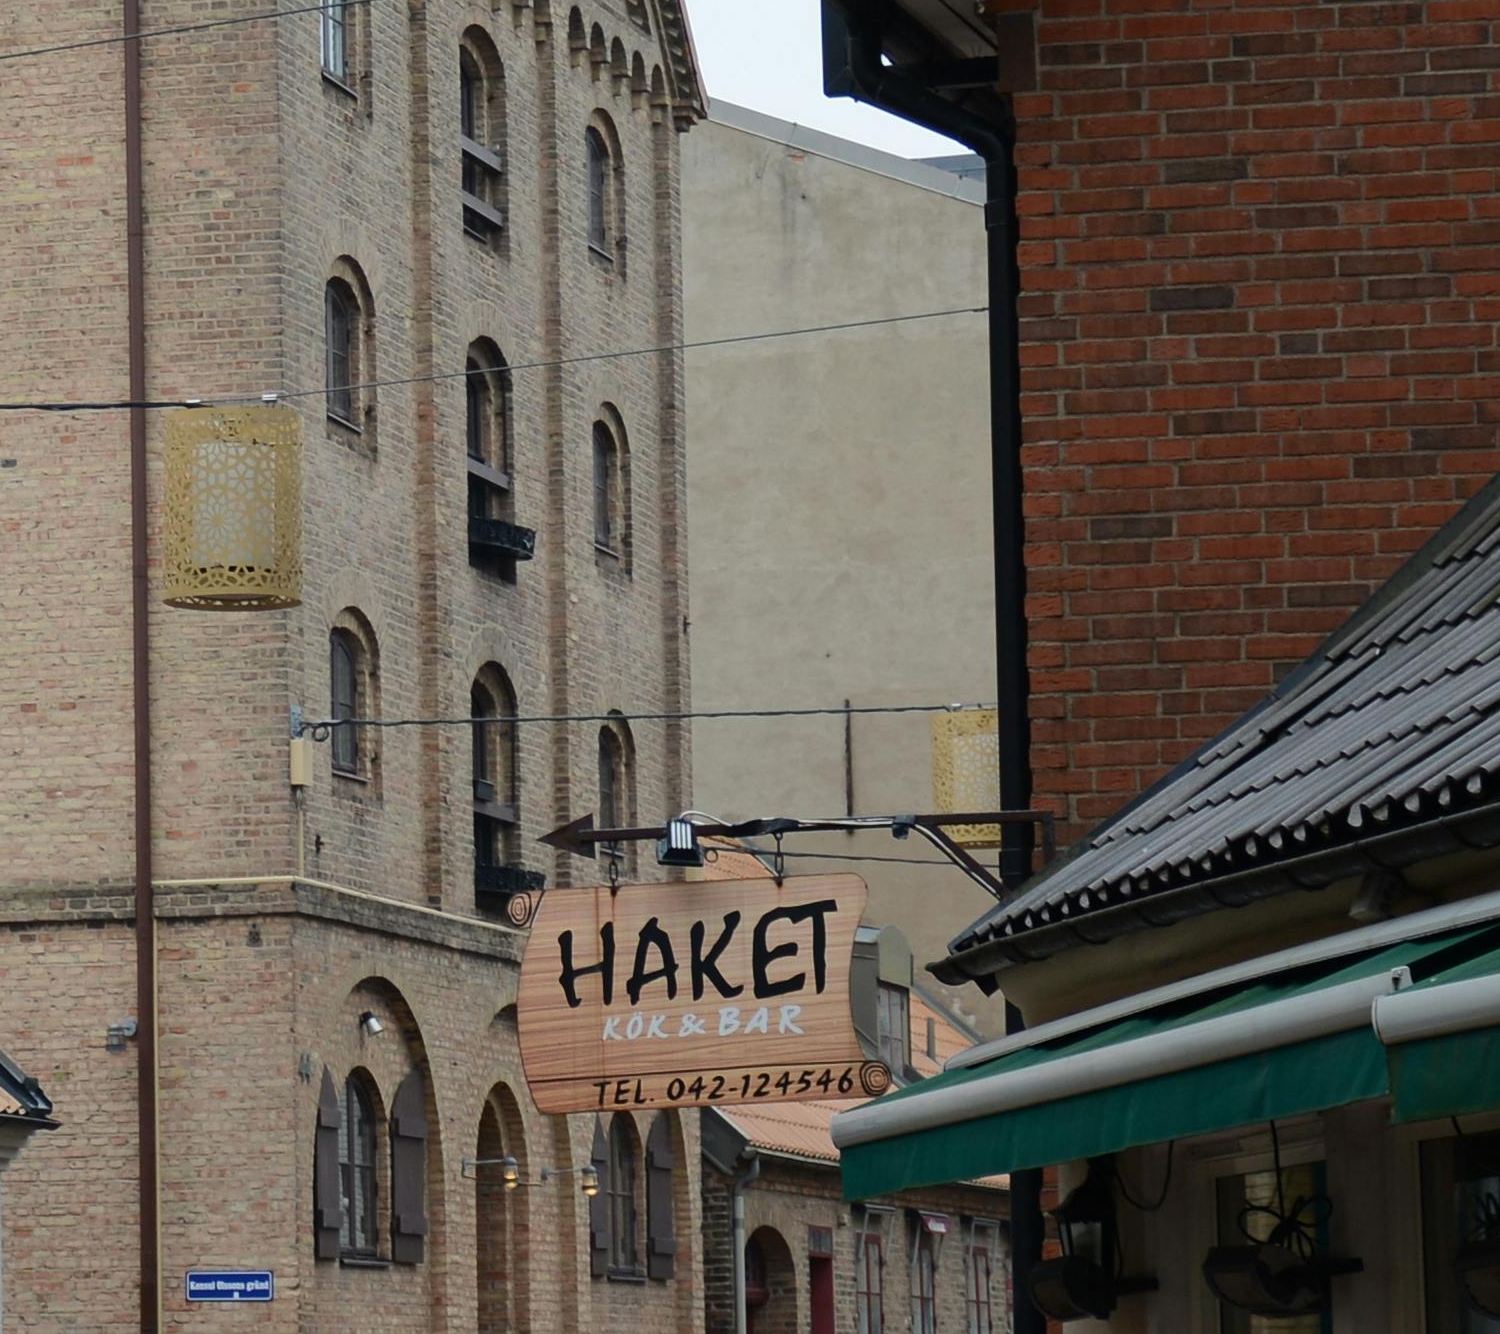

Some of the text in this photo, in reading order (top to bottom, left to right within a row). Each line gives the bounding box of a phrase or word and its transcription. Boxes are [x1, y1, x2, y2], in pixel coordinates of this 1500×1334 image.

[557, 899, 838, 1008] HAKET
[602, 1004, 806, 1042] KÖK & BAR
[593, 1067, 854, 1107] TEL. 042-124546
